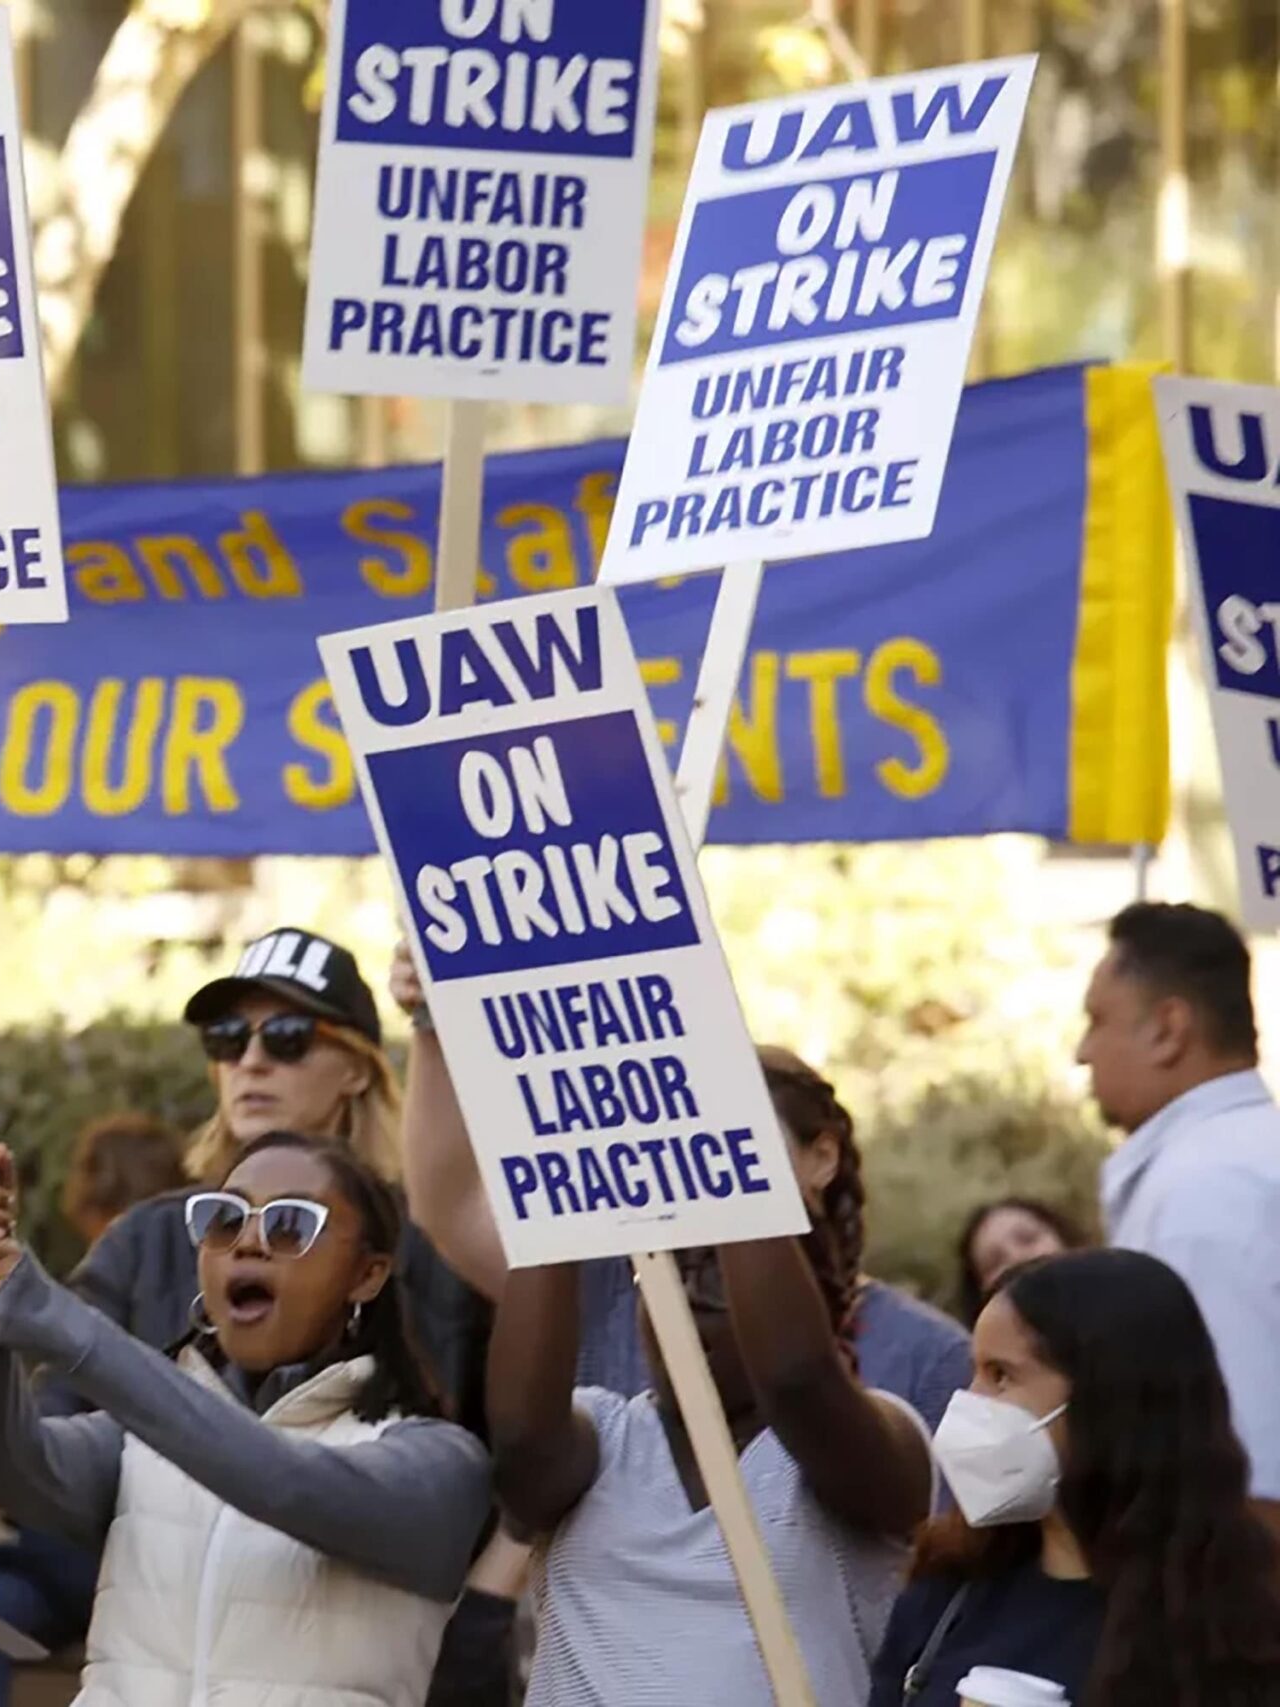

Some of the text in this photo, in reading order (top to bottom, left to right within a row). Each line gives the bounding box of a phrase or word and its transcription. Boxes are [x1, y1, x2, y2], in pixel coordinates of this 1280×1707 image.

[346, 44, 634, 136] STRIKE
[720, 75, 1012, 172] UAW
[377, 165, 587, 230] UNFAIR
[776, 170, 899, 255] ON
[381, 234, 570, 296] LABOR
[674, 235, 967, 347] STRIKE
[328, 298, 611, 366] PRACTICE
[690, 346, 906, 421] UNFAIR
[685, 408, 881, 481] LABOR
[628, 460, 919, 549] PRACTICE
[68, 511, 303, 601] and
[348, 606, 605, 728] UAW
[458, 736, 573, 839] ON
[416, 831, 683, 953] STRIKE
[481, 973, 685, 1060] UNFAIR
[516, 1055, 700, 1136] LABOR
[500, 1128, 771, 1221] PRACTICE
